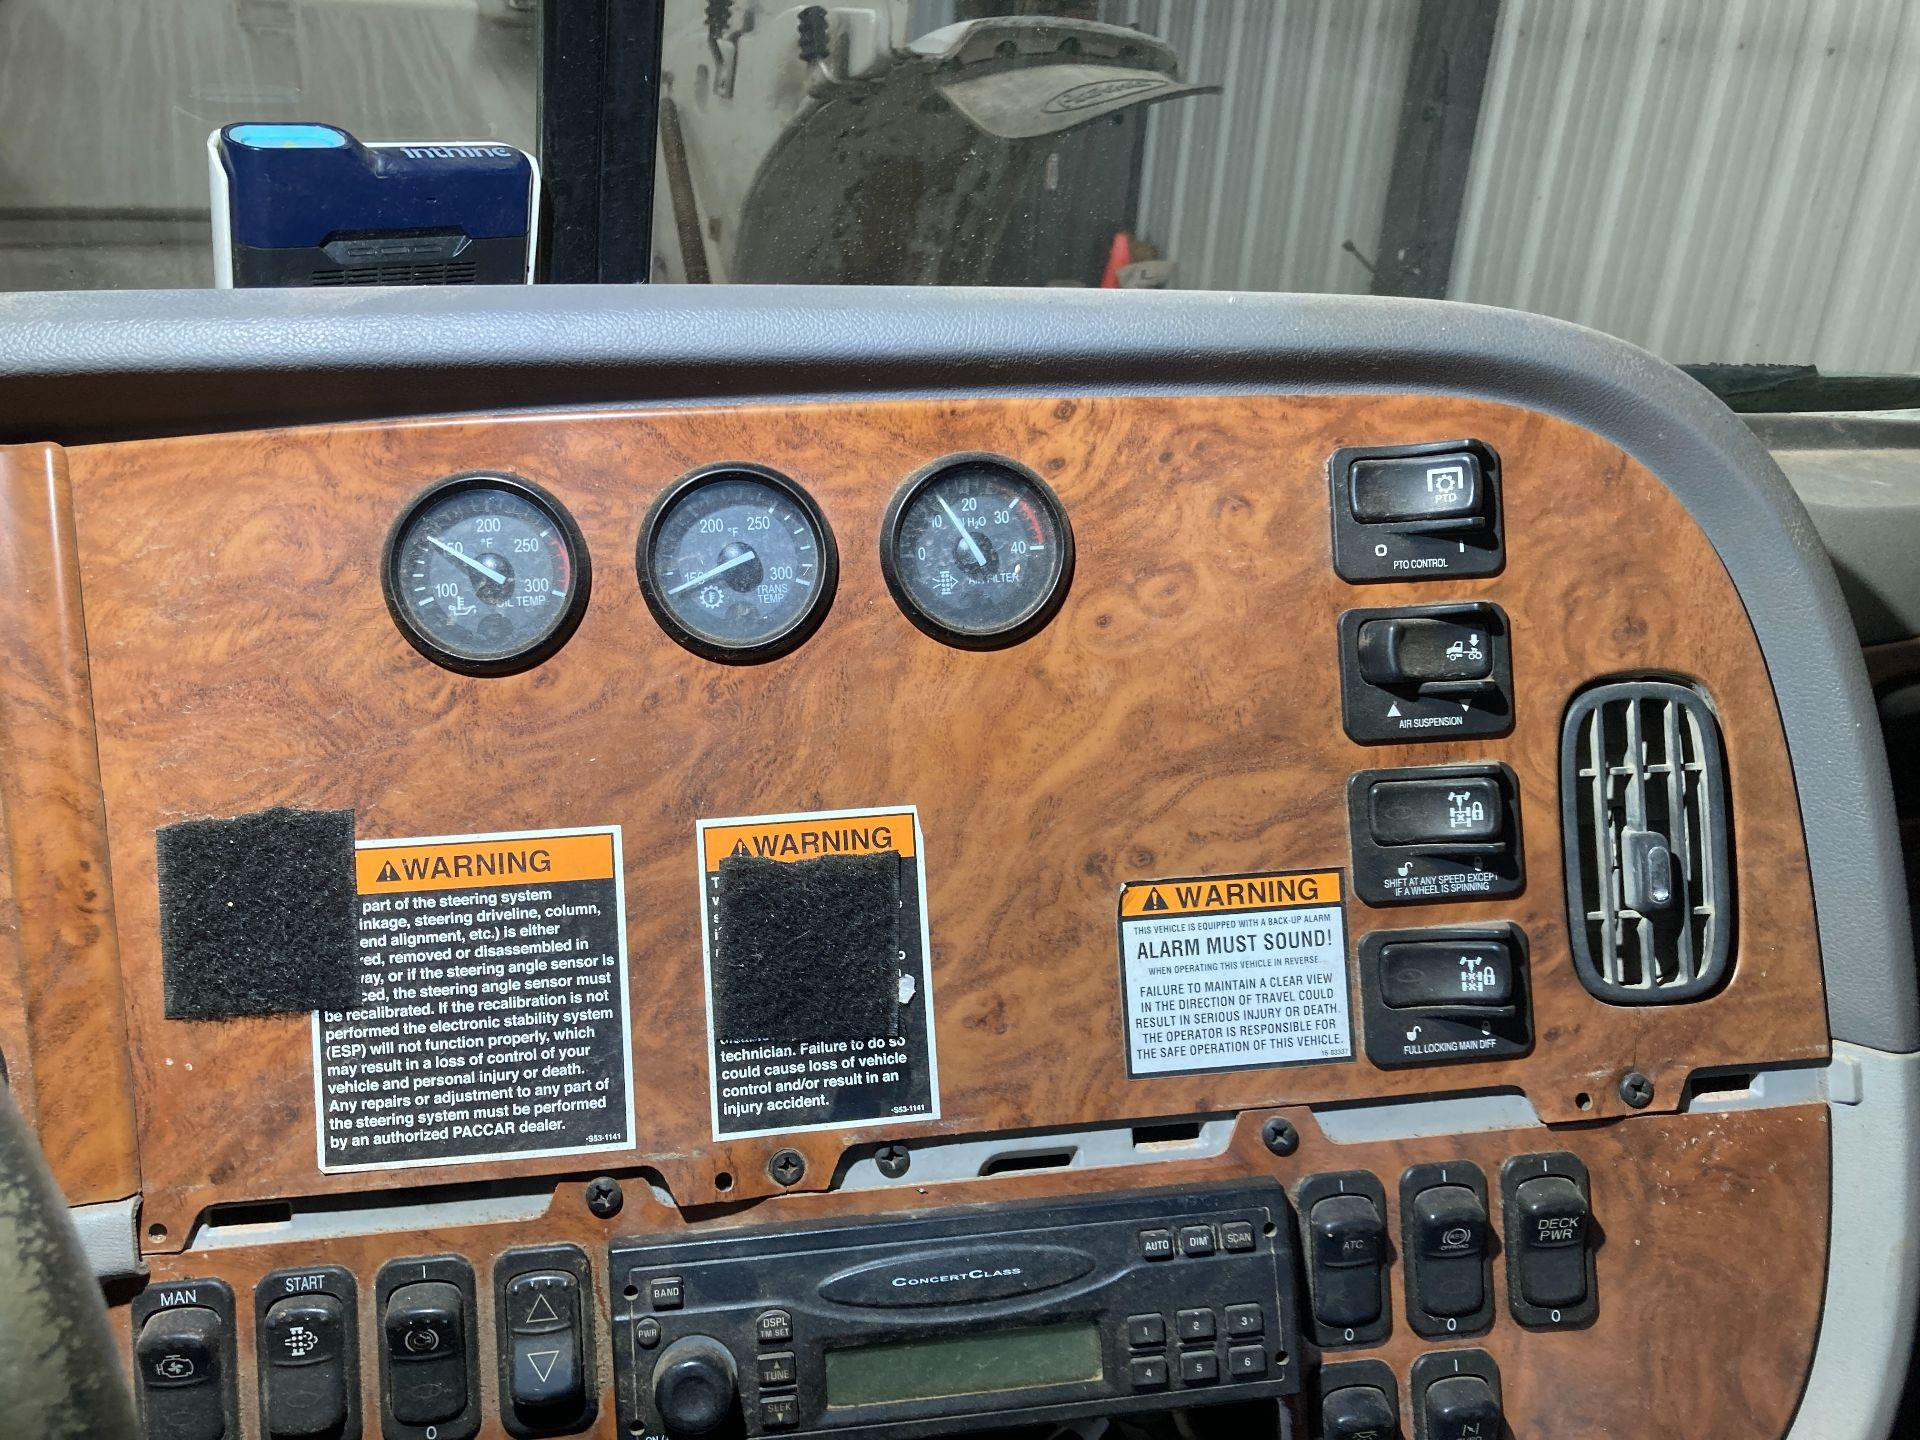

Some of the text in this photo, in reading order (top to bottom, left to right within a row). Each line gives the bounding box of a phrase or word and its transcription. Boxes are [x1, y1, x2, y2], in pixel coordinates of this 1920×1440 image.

[961, 498, 977, 512] 20
[476, 518, 501, 533] 200
[700, 519, 724, 533] 200
[747, 516, 770, 530] 250
[994, 511, 1009, 524] 30
[514, 538, 538, 552] 250
[918, 547, 926, 560] 0
[1011, 541, 1026, 554] 40
[1393, 558, 1448, 570] PTO CONTROL
[770, 566, 793, 580] 300
[435, 583, 458, 597] 100
[524, 578, 549, 592] 300
[756, 583, 788, 594] TRANS
[518, 596, 545, 606] TEMP
[758, 593, 784, 604] TEMP
[1399, 716, 1463, 729] AIR SUSPENSION
[753, 826, 892, 856] WARNING
[401, 849, 551, 881] WARNING
[1384, 879, 1408, 889] SHIFT
[1409, 878, 1421, 887] AT
[1421, 876, 1437, 886] ANY
[1438, 874, 1465, 885] SPEED
[1395, 882, 1490, 897] IF A WHEEL IS SPINNING
[439, 889, 552, 908] steering system
[1175, 878, 1319, 908] WARNING
[359, 904, 601, 931] inkage, steering driveline, column,
[1134, 914, 1331, 935] THIS VEHICLE EQUIPPED WITH BACK-UP ALARM
[391, 923, 560, 948] alignment, etc.) either
[1137, 928, 1332, 960] ALARM MUST SOUND!
[389, 947, 452, 964] removed
[474, 938, 572, 958] disassembled
[447, 957, 599, 978] steering angle sensor
[1148, 966, 1172, 975] WHEN
[1175, 962, 1218, 974] OPERATING
[1221, 961, 1237, 970] THIS
[1240, 959, 1272, 969] VEHICLE
[420, 976, 573, 998] steering angle sensor
[1140, 973, 1333, 997] FAILURE MAINTAIN CLEAR VIEW
[346, 993, 566, 1021] recalibrated. recalibration
[1155, 988, 1334, 1012] THE DIRECTION TRAVEL COULD
[1136, 1003, 1341, 1029] RESULT SERIOUS INJURY DEATH.
[325, 1008, 614, 1043] performed electronic stability system
[1143, 1019, 1336, 1044] THE OPERATOR RESPONSIBLE FOR
[326, 1026, 595, 1061] (ESP) function properly, which
[721, 1046, 796, 1063] technician.
[801, 1041, 847, 1055] Failure
[1137, 1034, 1344, 1060] THE SAFE OPERATION THIS VEHICLE.
[1403, 1038, 1497, 1055] FULL LOCKING MAIN DIFF
[361, 1048, 537, 1074] result control
[721, 1052, 907, 1080] could cause loss vehicle
[327, 1063, 585, 1094] vehicle personal injury death.
[722, 1072, 862, 1098] control and/or result
[361, 1087, 513, 1112] repairs adjustment
[723, 1094, 830, 1117] injury accident.
[355, 1096, 607, 1128] steering system performed
[373, 1119, 566, 1145] authorized PACCAR dealer.
[1538, 1217, 1580, 1230] DECK
[1189, 1236, 1207, 1247] DIM
[1227, 1232, 1251, 1243] SCAN
[1540, 1228, 1573, 1241] PWR
[1145, 1241, 1169, 1250] AUTO
[1343, 1240, 1364, 1250] ATC
[286, 1275, 325, 1293] START
[654, 1287, 679, 1298] BAND
[160, 1290, 197, 1307] MAN
[763, 1317, 788, 1328] DSPL
[1193, 1317, 1248, 1330] 2 3
[638, 1328, 657, 1338] PWR
[760, 1328, 790, 1338] TM SET
[764, 1370, 790, 1381] TUNE
[1146, 1357, 1251, 1378] 4 5 6
